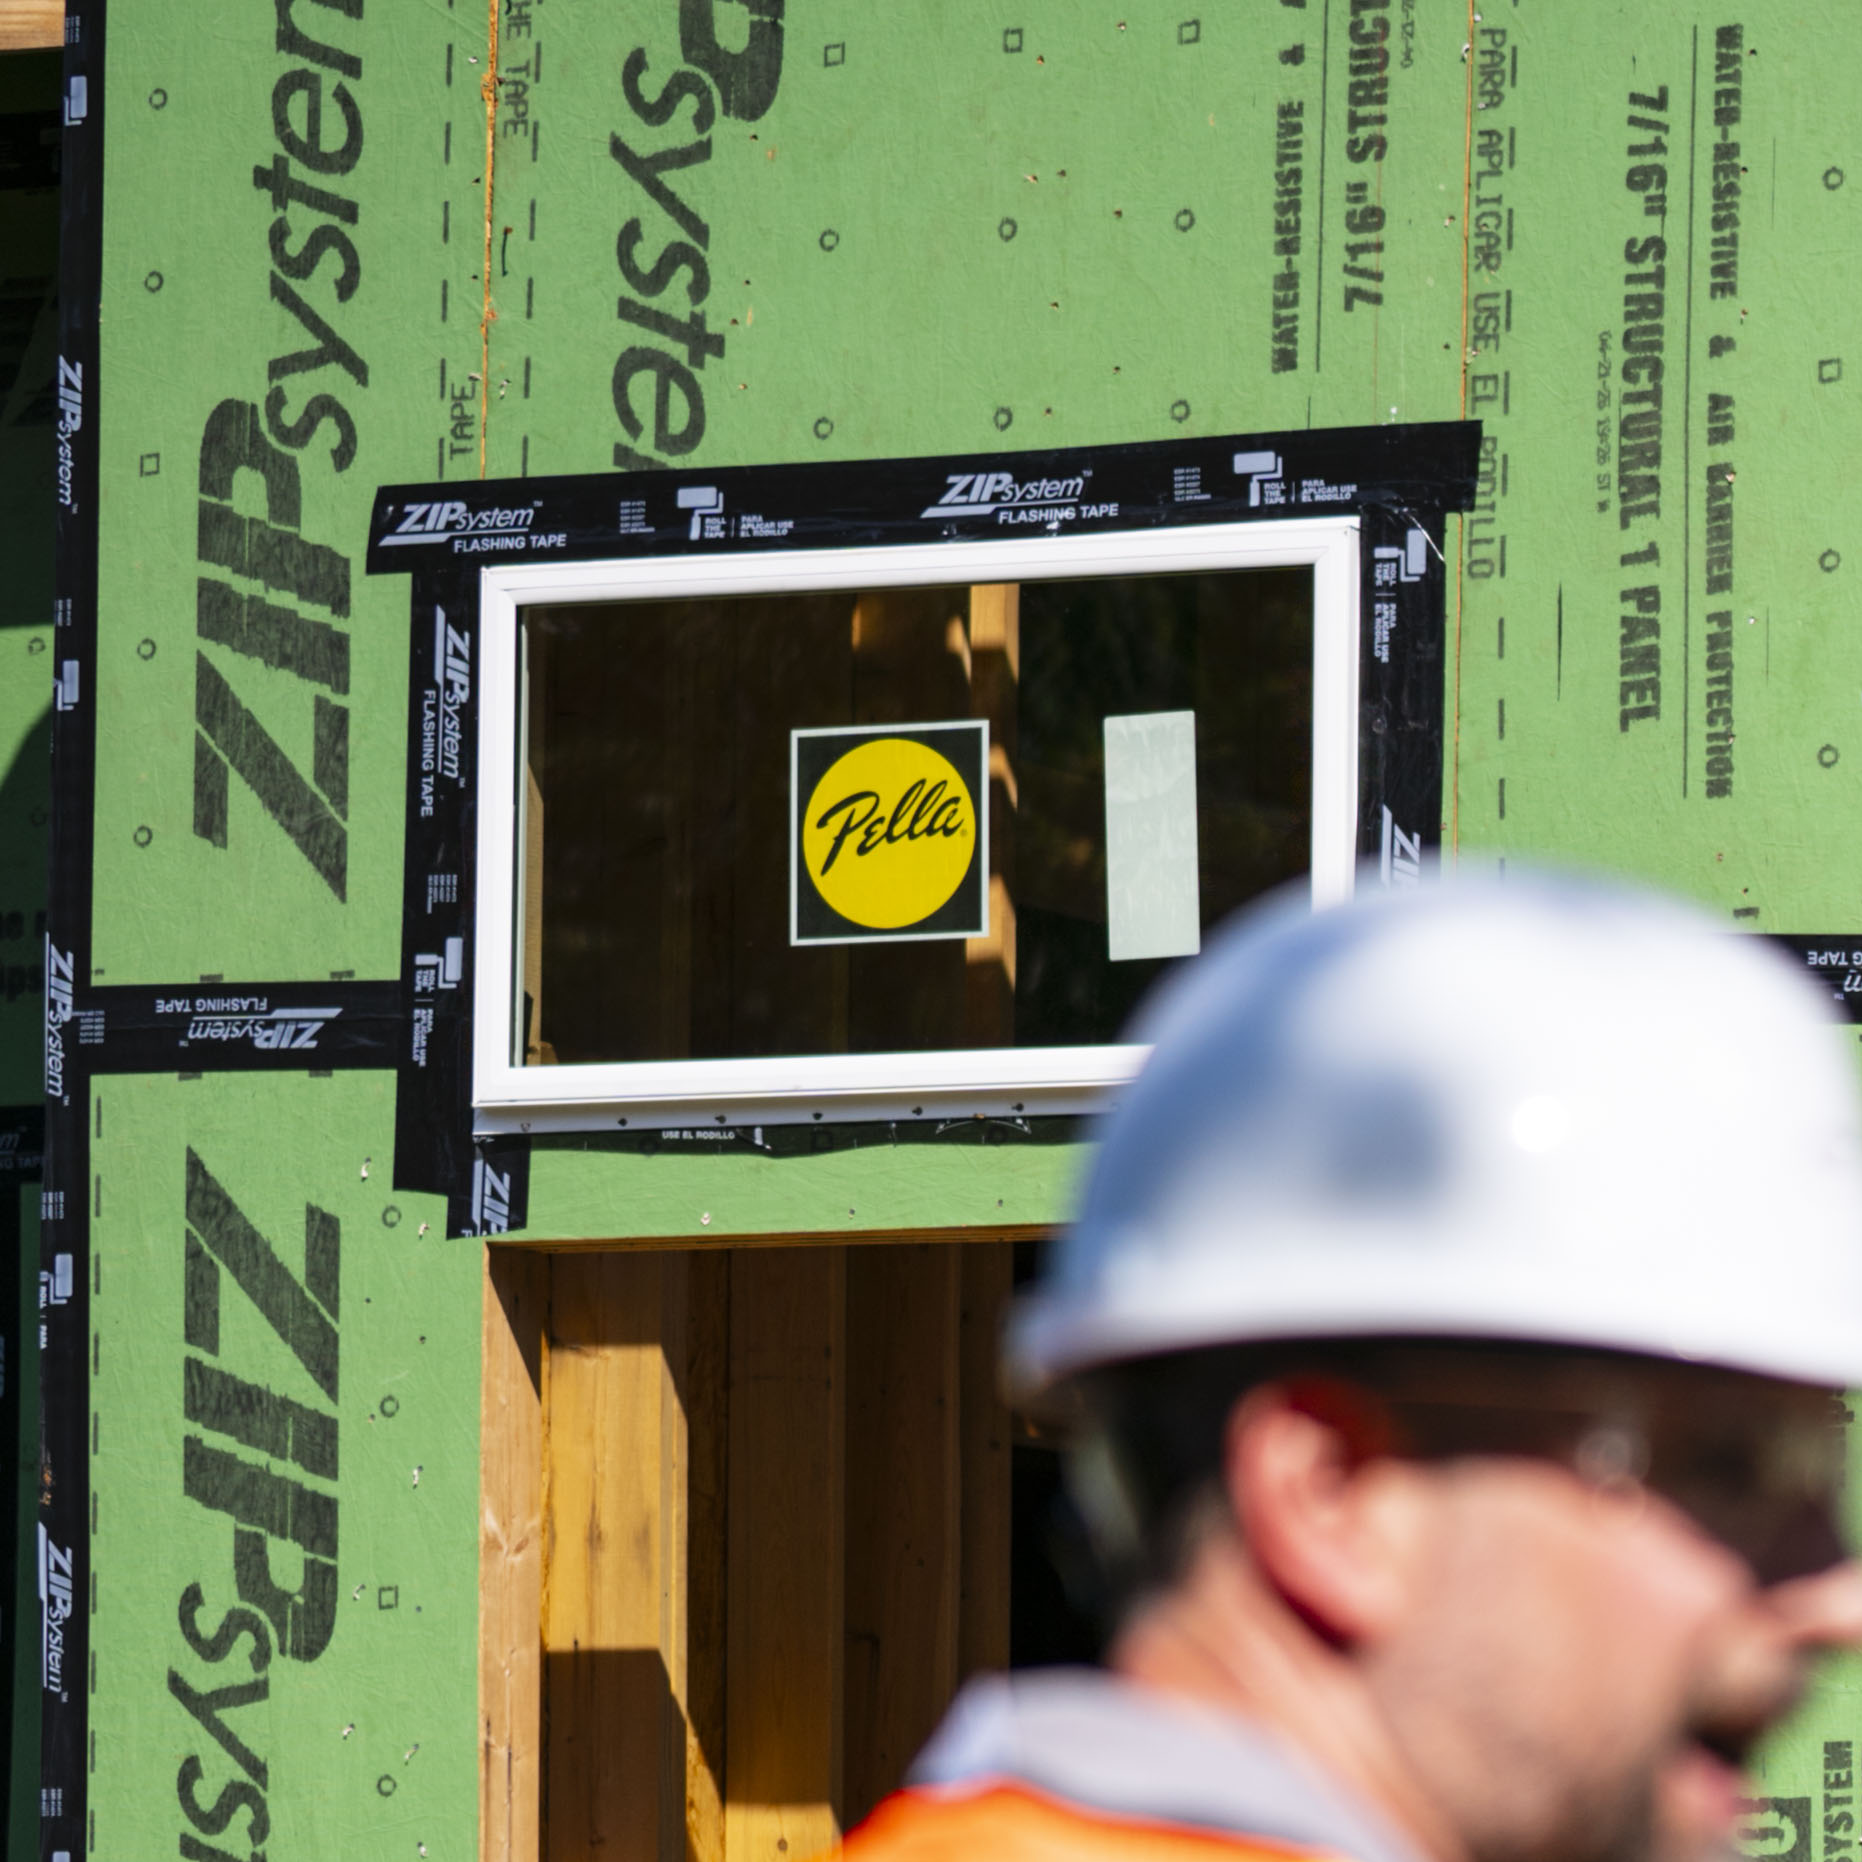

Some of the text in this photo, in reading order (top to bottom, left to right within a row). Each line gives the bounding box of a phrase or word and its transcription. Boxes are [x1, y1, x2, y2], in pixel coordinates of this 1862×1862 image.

[503, 0, 532, 139] HE TAPE
[1479, 28, 1505, 110] PARA
[1474, 129, 1503, 273] APLICAR
[1708, 25, 1744, 299] WATER-RESISTIVE
[1272, 100, 1304, 373] WATER-RESISTIVE
[1473, 292, 1500, 353] USE
[450, 380, 478, 461] TAPE
[1470, 374, 1498, 415] EL
[1620, 238, 1666, 529] STRUCTURAL
[1708, 394, 1736, 447] AIR
[454, 534, 566, 552] FLASHING TAPE
[998, 503, 1118, 525] FLASHING TAPE
[1708, 463, 1735, 595] BARRIER
[1620, 585, 1661, 733] PANEL
[1707, 610, 1734, 798] PROTECTION
[421, 690, 436, 817] FLASHING TAPE
[816, 778, 964, 876] Pella
[156, 997, 268, 1014] FLASHING TAPE
